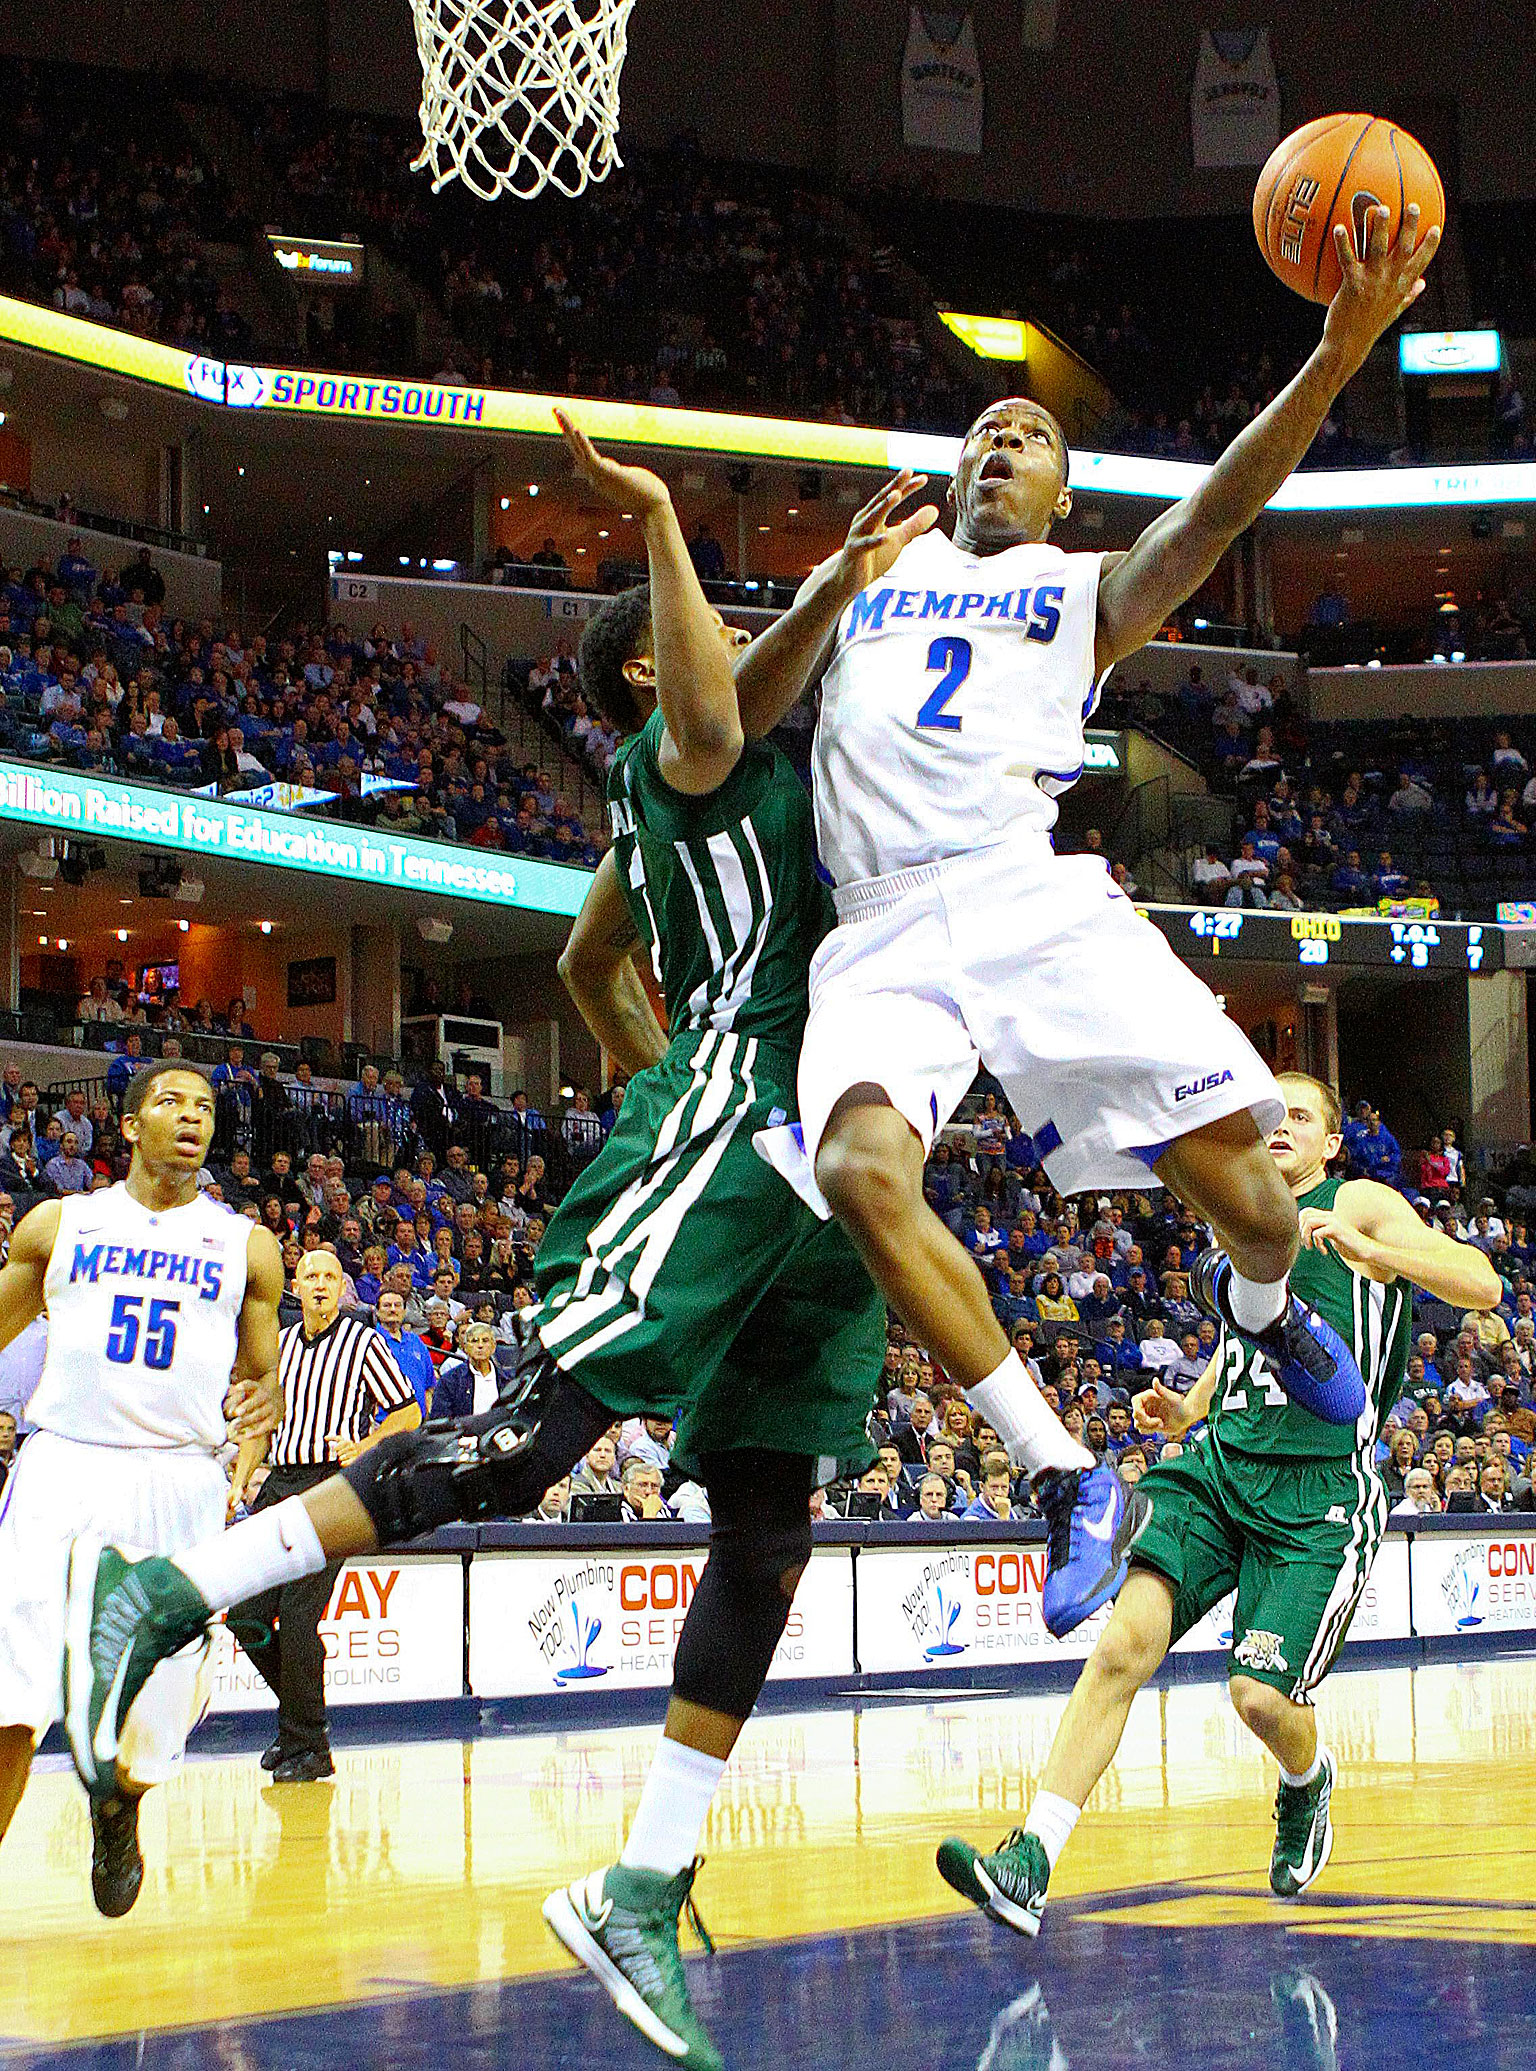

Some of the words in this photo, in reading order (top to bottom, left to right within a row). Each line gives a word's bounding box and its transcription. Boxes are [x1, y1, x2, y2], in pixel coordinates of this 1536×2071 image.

[1281, 177, 1321, 265] ELITE
[201, 363, 245, 390] FOX
[272, 374, 485, 422] SPORTSOUTH
[349, 583, 367, 598] C2
[562, 601, 579, 616] C1
[845, 585, 1066, 645] MEMPHIS
[914, 635, 973, 733] 2
[85, 788, 179, 837] Raised
[182, 804, 225, 844] for
[227, 815, 358, 869] Education
[361, 837, 386, 874] in
[389, 844, 517, 897] Tennessee
[1188, 911, 1244, 939] 4:27
[1290, 916, 1342, 941] OHIO
[1298, 938, 1330, 966] 20
[1465, 945, 1485, 972] 7
[68, 1242, 225, 1302] MEMPHIS
[106, 1293, 181, 1371] 55
[1221, 1337, 1288, 1411] 24
[620, 1564, 700, 1611] CON
[902, 1581, 924, 1621] Now
[923, 1548, 970, 1590] Plumbing
[975, 1553, 1045, 1596] CON
[1488, 1542, 1534, 1577] CON
[528, 1595, 556, 1641] Now
[554, 1558, 614, 1605] Plumbing
[1488, 1582, 1536, 1603] SERV
[974, 1632, 1039, 1649] HEATING
